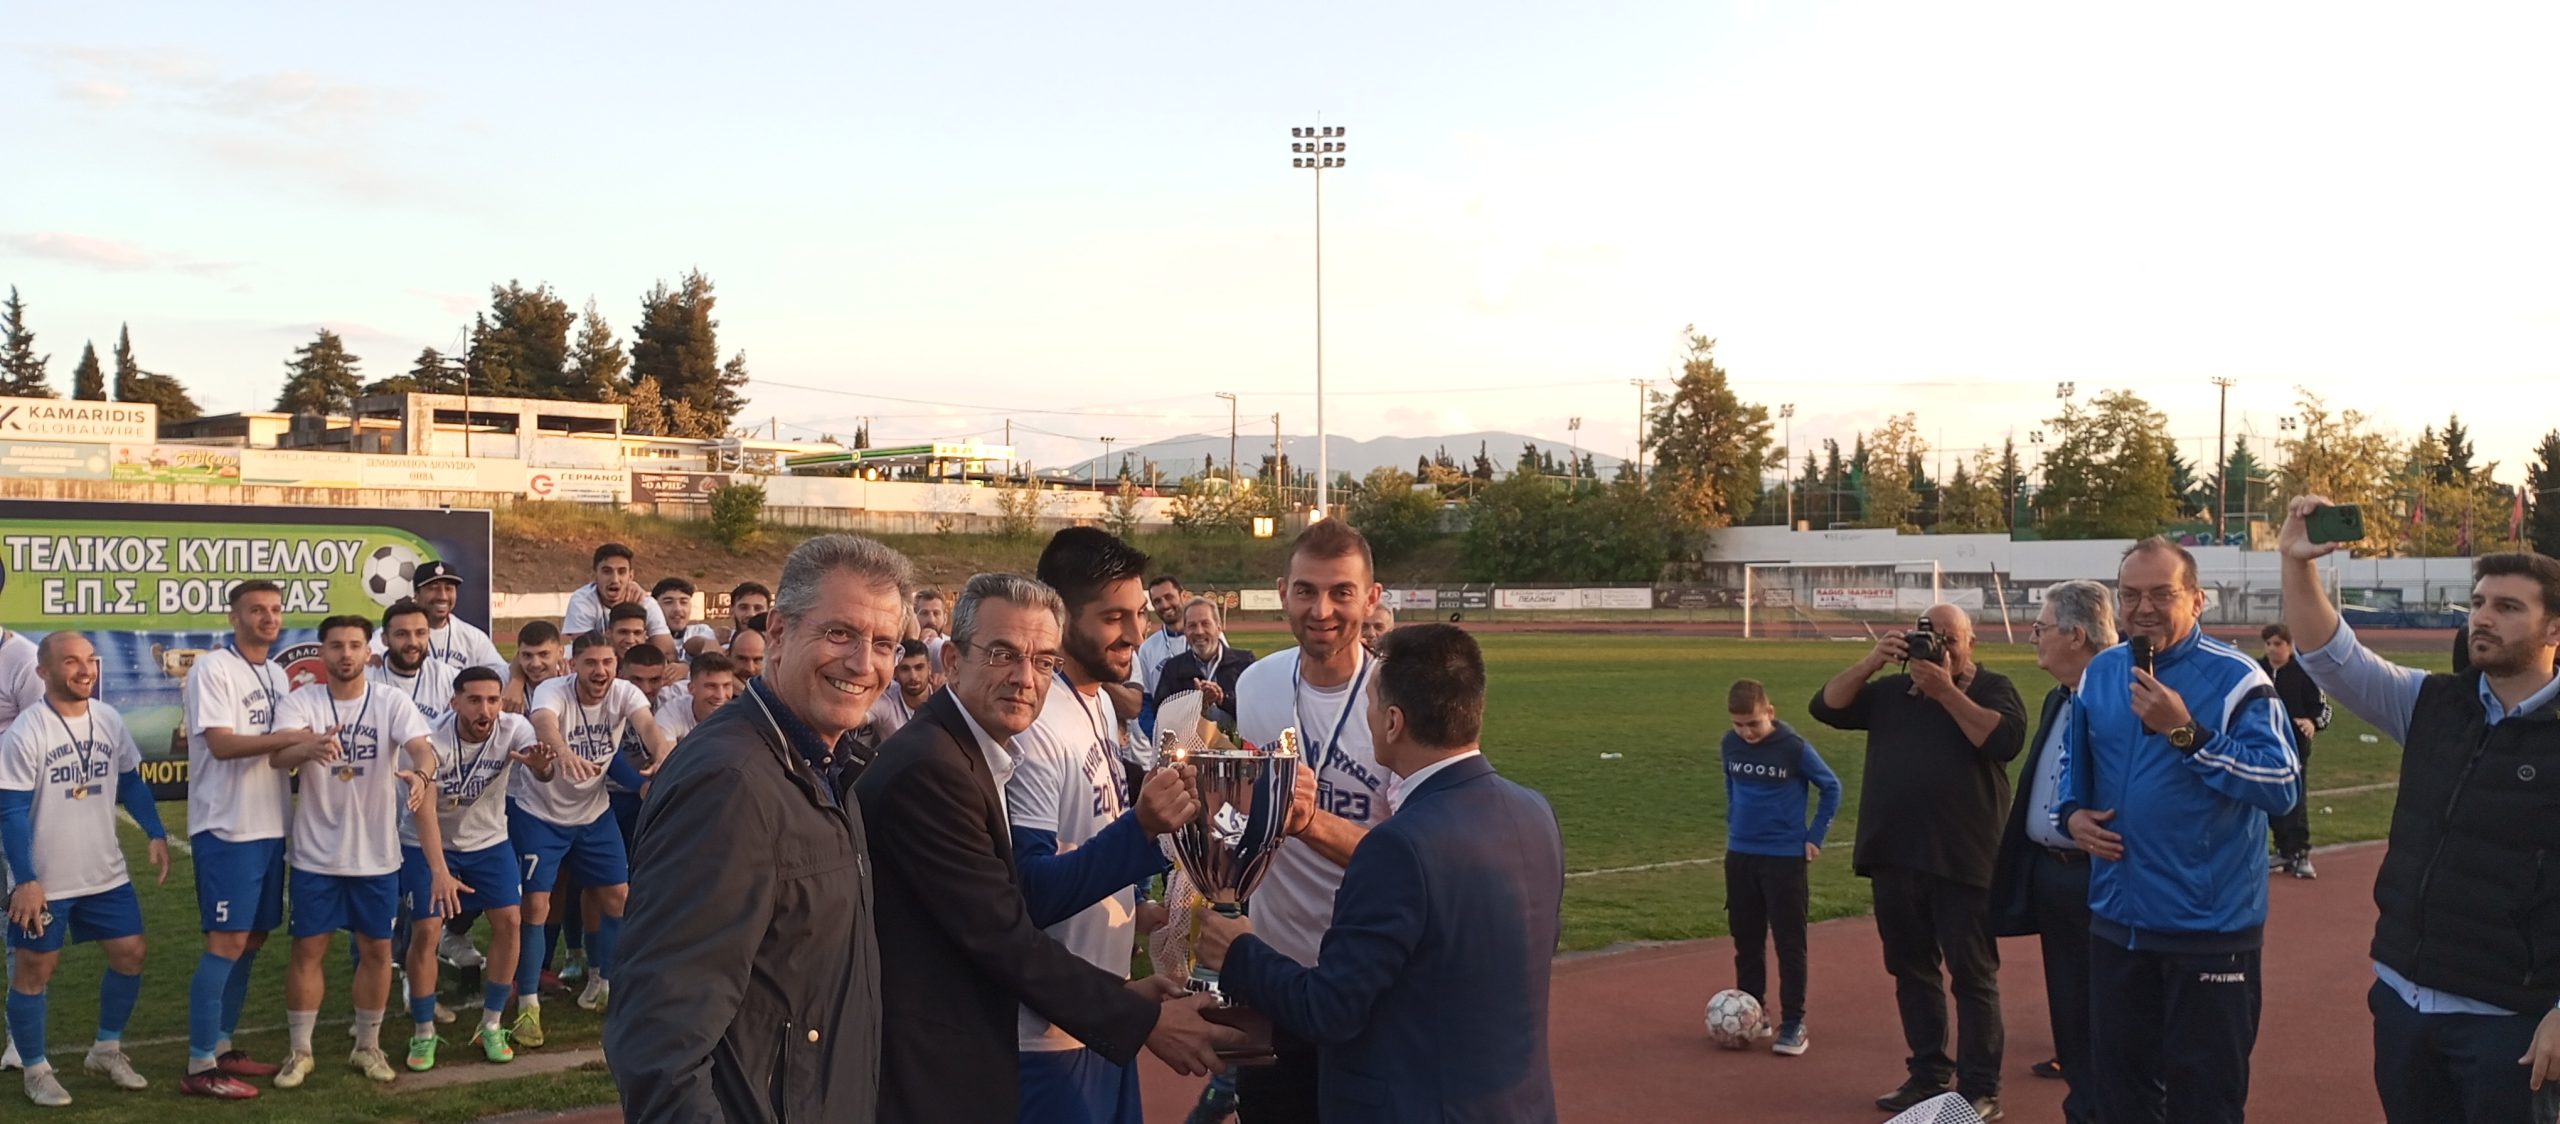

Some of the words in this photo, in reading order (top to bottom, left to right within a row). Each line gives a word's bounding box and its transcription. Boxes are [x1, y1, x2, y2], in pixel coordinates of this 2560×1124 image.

[28, 405, 146, 423] KAMARIDIS
[27, 421, 145, 438] GLOBALWIRE
[560, 473, 625, 482] ΓΕΡΜΑΝΟΣ
[5, 536, 169, 572] ΤΕΛΙΚΟΣ
[177, 538, 362, 573] ΚΥΠΕΛΛΟΥ
[42, 578, 147, 614] Ε.Π.Σ.
[248, 709, 266, 725] 20
[356, 744, 377, 760] 23
[50, 766, 71, 783] 20
[1093, 784, 1111, 817] 20
[1333, 788, 1371, 820] 23
[525, 854, 540, 880] 7
[216, 901, 229, 922] 5
